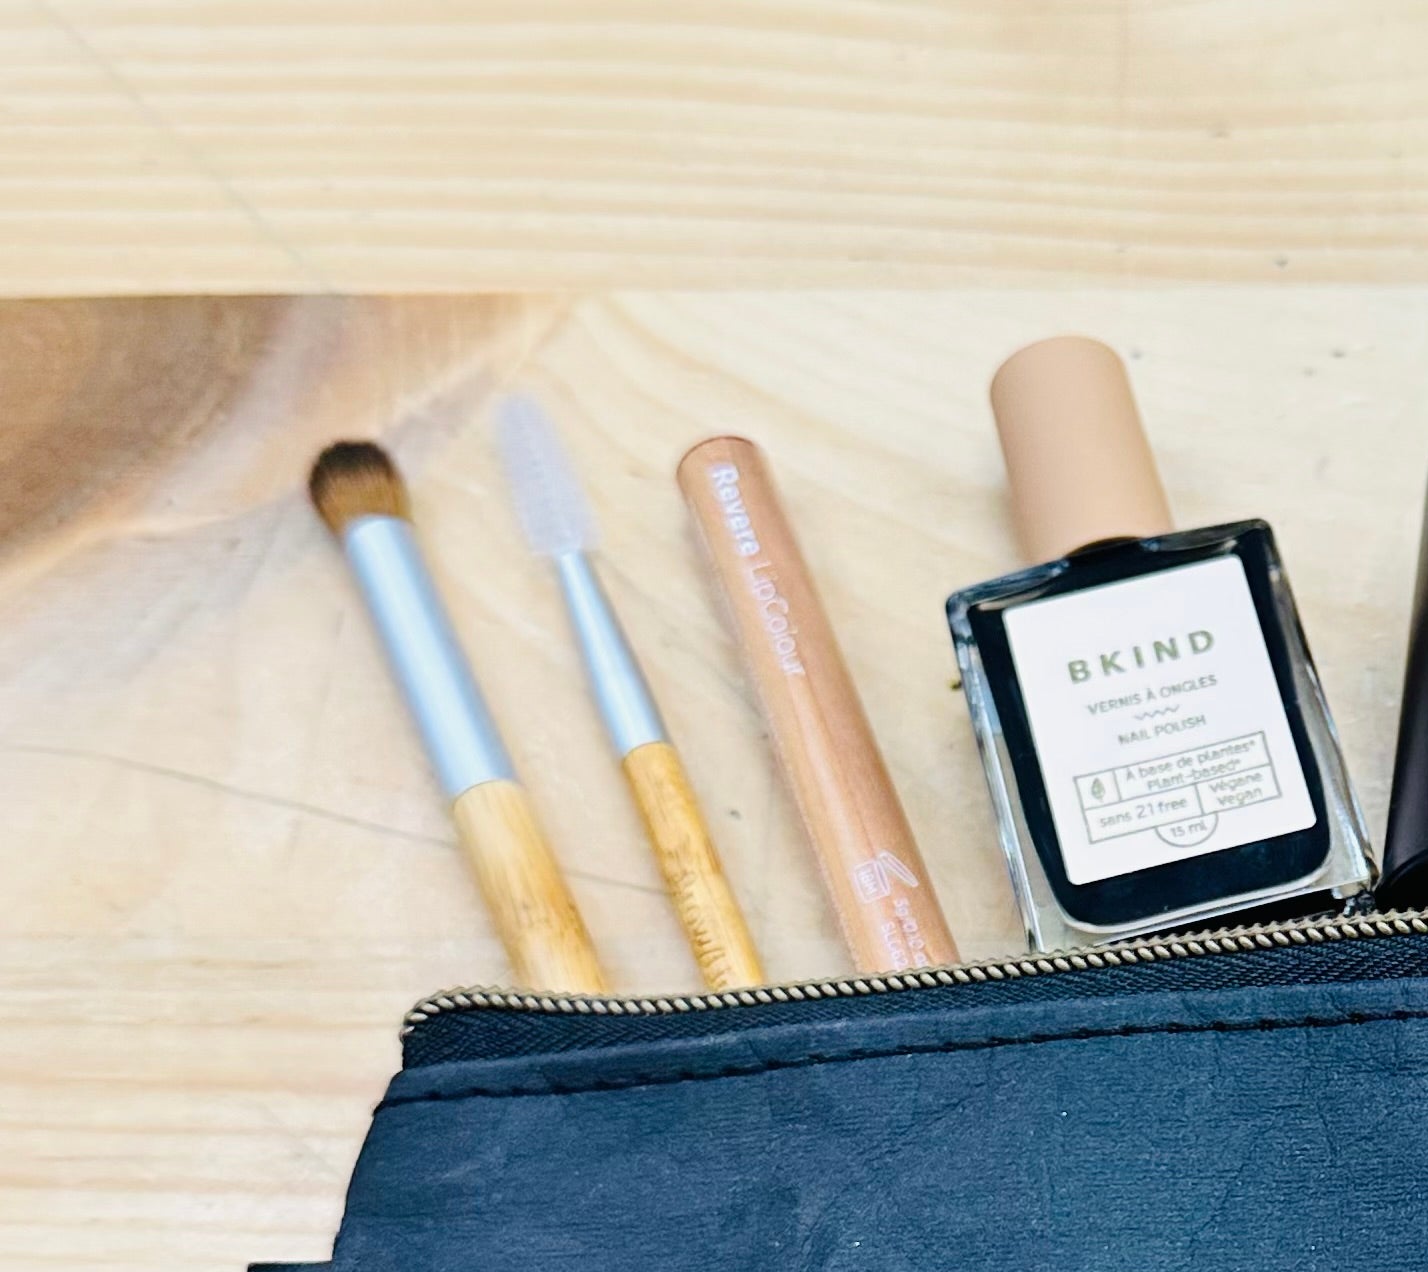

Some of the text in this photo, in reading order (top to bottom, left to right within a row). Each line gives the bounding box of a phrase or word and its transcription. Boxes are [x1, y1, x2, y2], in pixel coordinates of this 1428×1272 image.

[711, 465, 806, 677] Revere LipColour
[1067, 630, 1214, 684] BKIND
[1086, 693, 1142, 715] VERNIS
[1160, 674, 1218, 698] ONGLES
[1118, 715, 1207, 745] NAIL POLISH
[1139, 761, 1173, 778] base
[1176, 756, 1194, 771] de
[1100, 811, 1133, 828] sans
[1157, 798, 1188, 813] free
[1170, 821, 1208, 838] 15 ml
